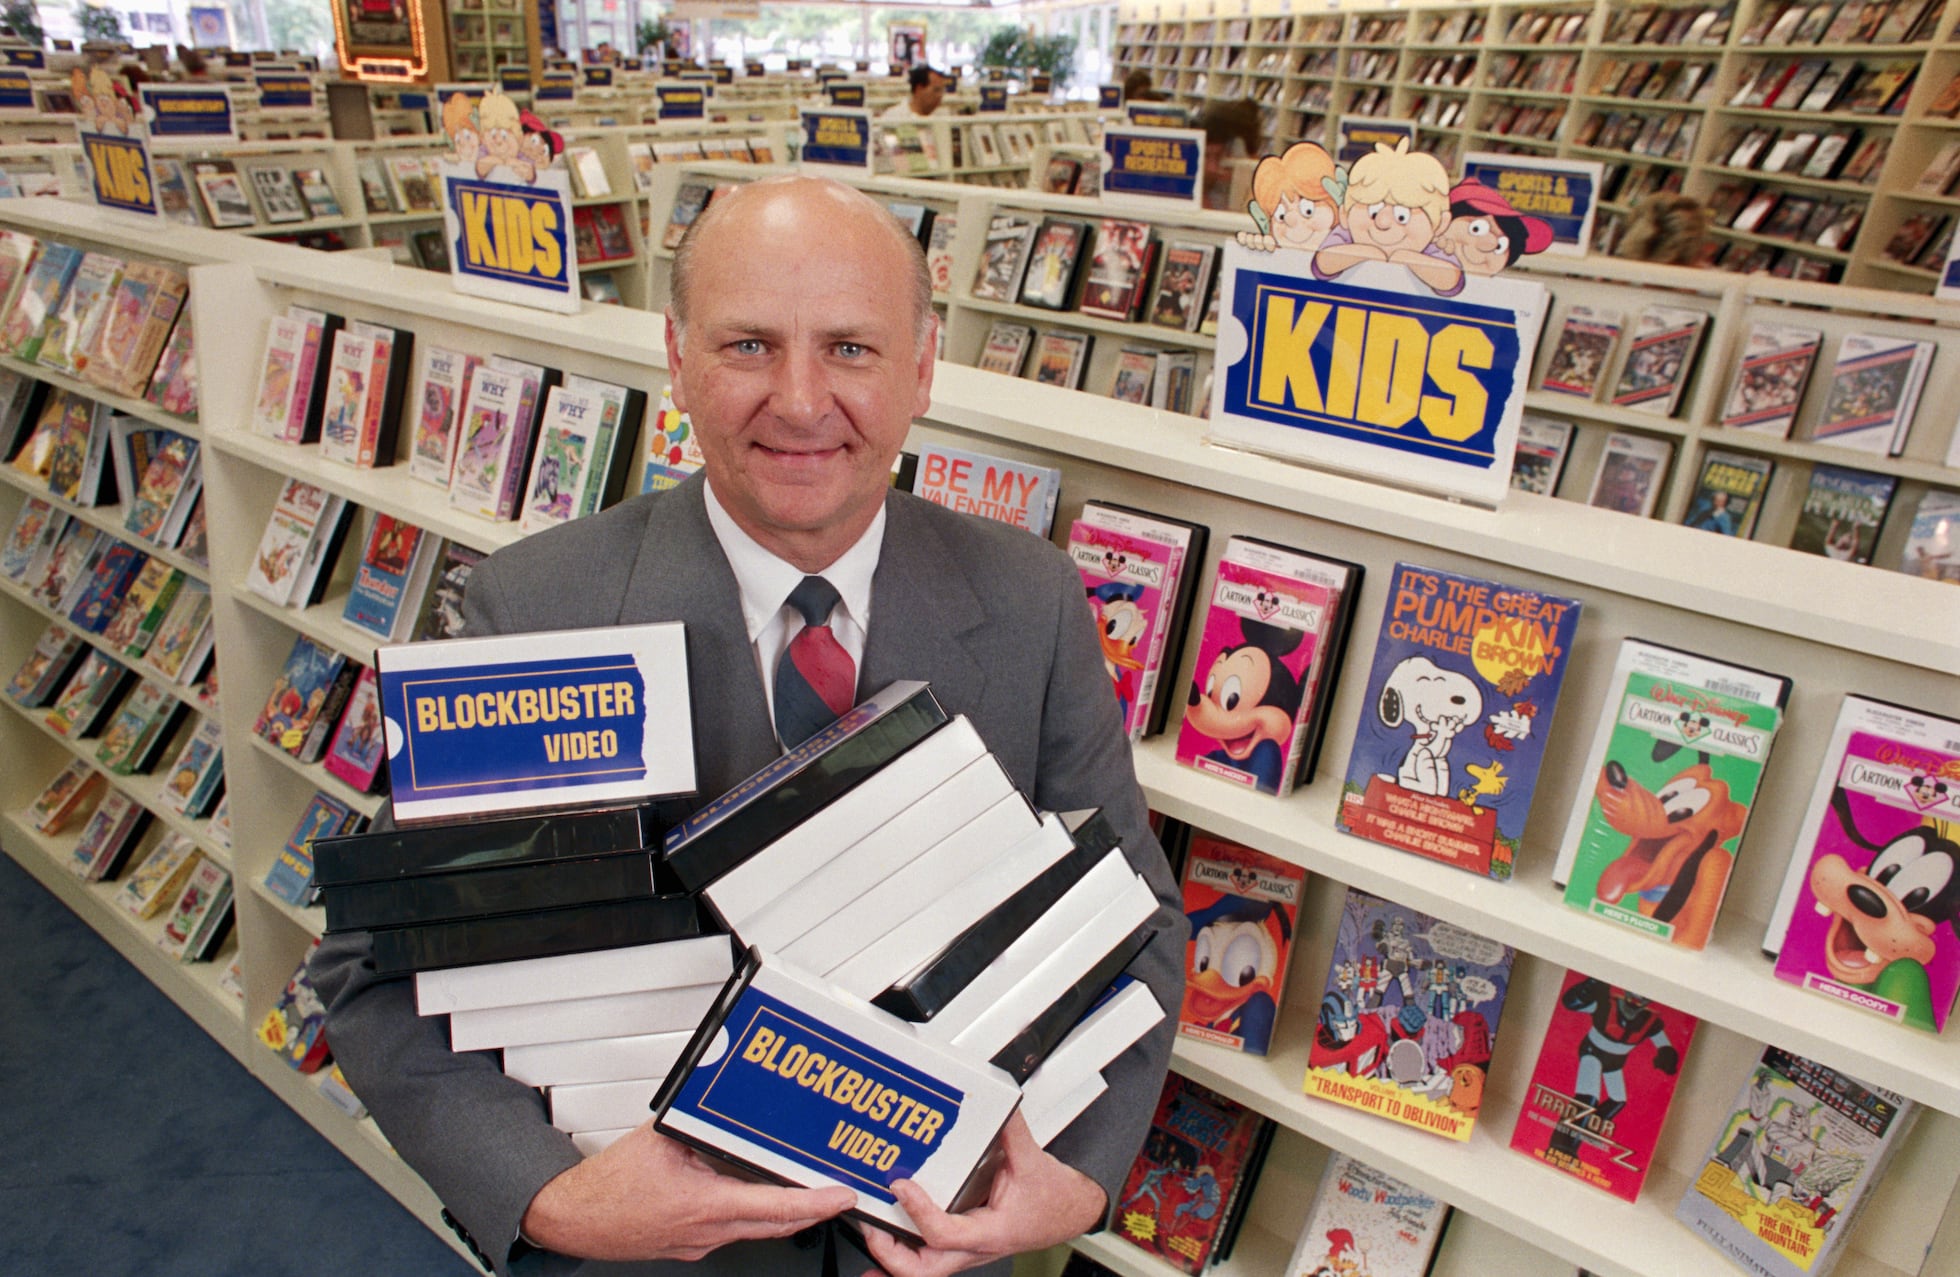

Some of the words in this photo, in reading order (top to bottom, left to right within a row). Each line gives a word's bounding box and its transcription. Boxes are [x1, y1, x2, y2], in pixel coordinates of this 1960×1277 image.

[1124, 155, 1187, 174] RECREATION
[1130, 139, 1170, 158] SPORTS
[1171, 142, 1182, 159] &
[90, 143, 151, 205] KIDS
[1498, 172, 1553, 194] SPORTS
[1554, 176, 1568, 196] &
[461, 191, 562, 278] KIDS
[1258, 295, 1495, 442] KIDS
[481, 381, 509, 398] WHY
[559, 400, 588, 419] WHY
[923, 453, 973, 494] BE
[982, 466, 1039, 508] MY
[1072, 546, 1101, 562] CARTOON
[1128, 563, 1159, 584] CLASSICS
[1220, 586, 1252, 605] CARTOON
[1281, 605, 1317, 628] CLASSICS
[1400, 571, 1439, 595] IT'S
[1446, 580, 1489, 606] THE
[1493, 592, 1568, 623] GREAT
[1393, 590, 1562, 657] PUMPKIN,
[1389, 621, 1472, 655] CHARLIE
[1476, 641, 1556, 675] BROWN
[415, 681, 635, 733] BLOCKBUSTER
[1650, 681, 1686, 707] Walt
[1687, 689, 1750, 728] Disney
[543, 729, 618, 763] VIDEO
[796, 722, 857, 762] VIDEO
[1629, 702, 1672, 726] CARTOON
[1713, 728, 1760, 754] CLASSICS
[692, 708, 866, 826] BLOCKBUSTER
[1851, 763, 1902, 791] CARTOON
[1876, 742, 1918, 772] Walt
[1195, 862, 1229, 880] CARTOON
[1260, 879, 1295, 899] CLASSICS
[1819, 982, 1849, 998] HERE'S
[742, 1025, 945, 1145] BLOCKBUSTER
[1312, 1074, 1384, 1111] "TRANSPORT
[1386, 1099, 1402, 1116] TO
[1402, 1105, 1466, 1134] OBLIVION"
[828, 1121, 901, 1171] VIDEO
[1339, 1178, 1372, 1203] Woody
[1696, 1218, 1725, 1246] FULLY
[1756, 1212, 1778, 1230] "FIRE
[1779, 1224, 1793, 1238] ON
[1794, 1229, 1812, 1245] THE
[1758, 1226, 1814, 1257] MOUNTAIN"
